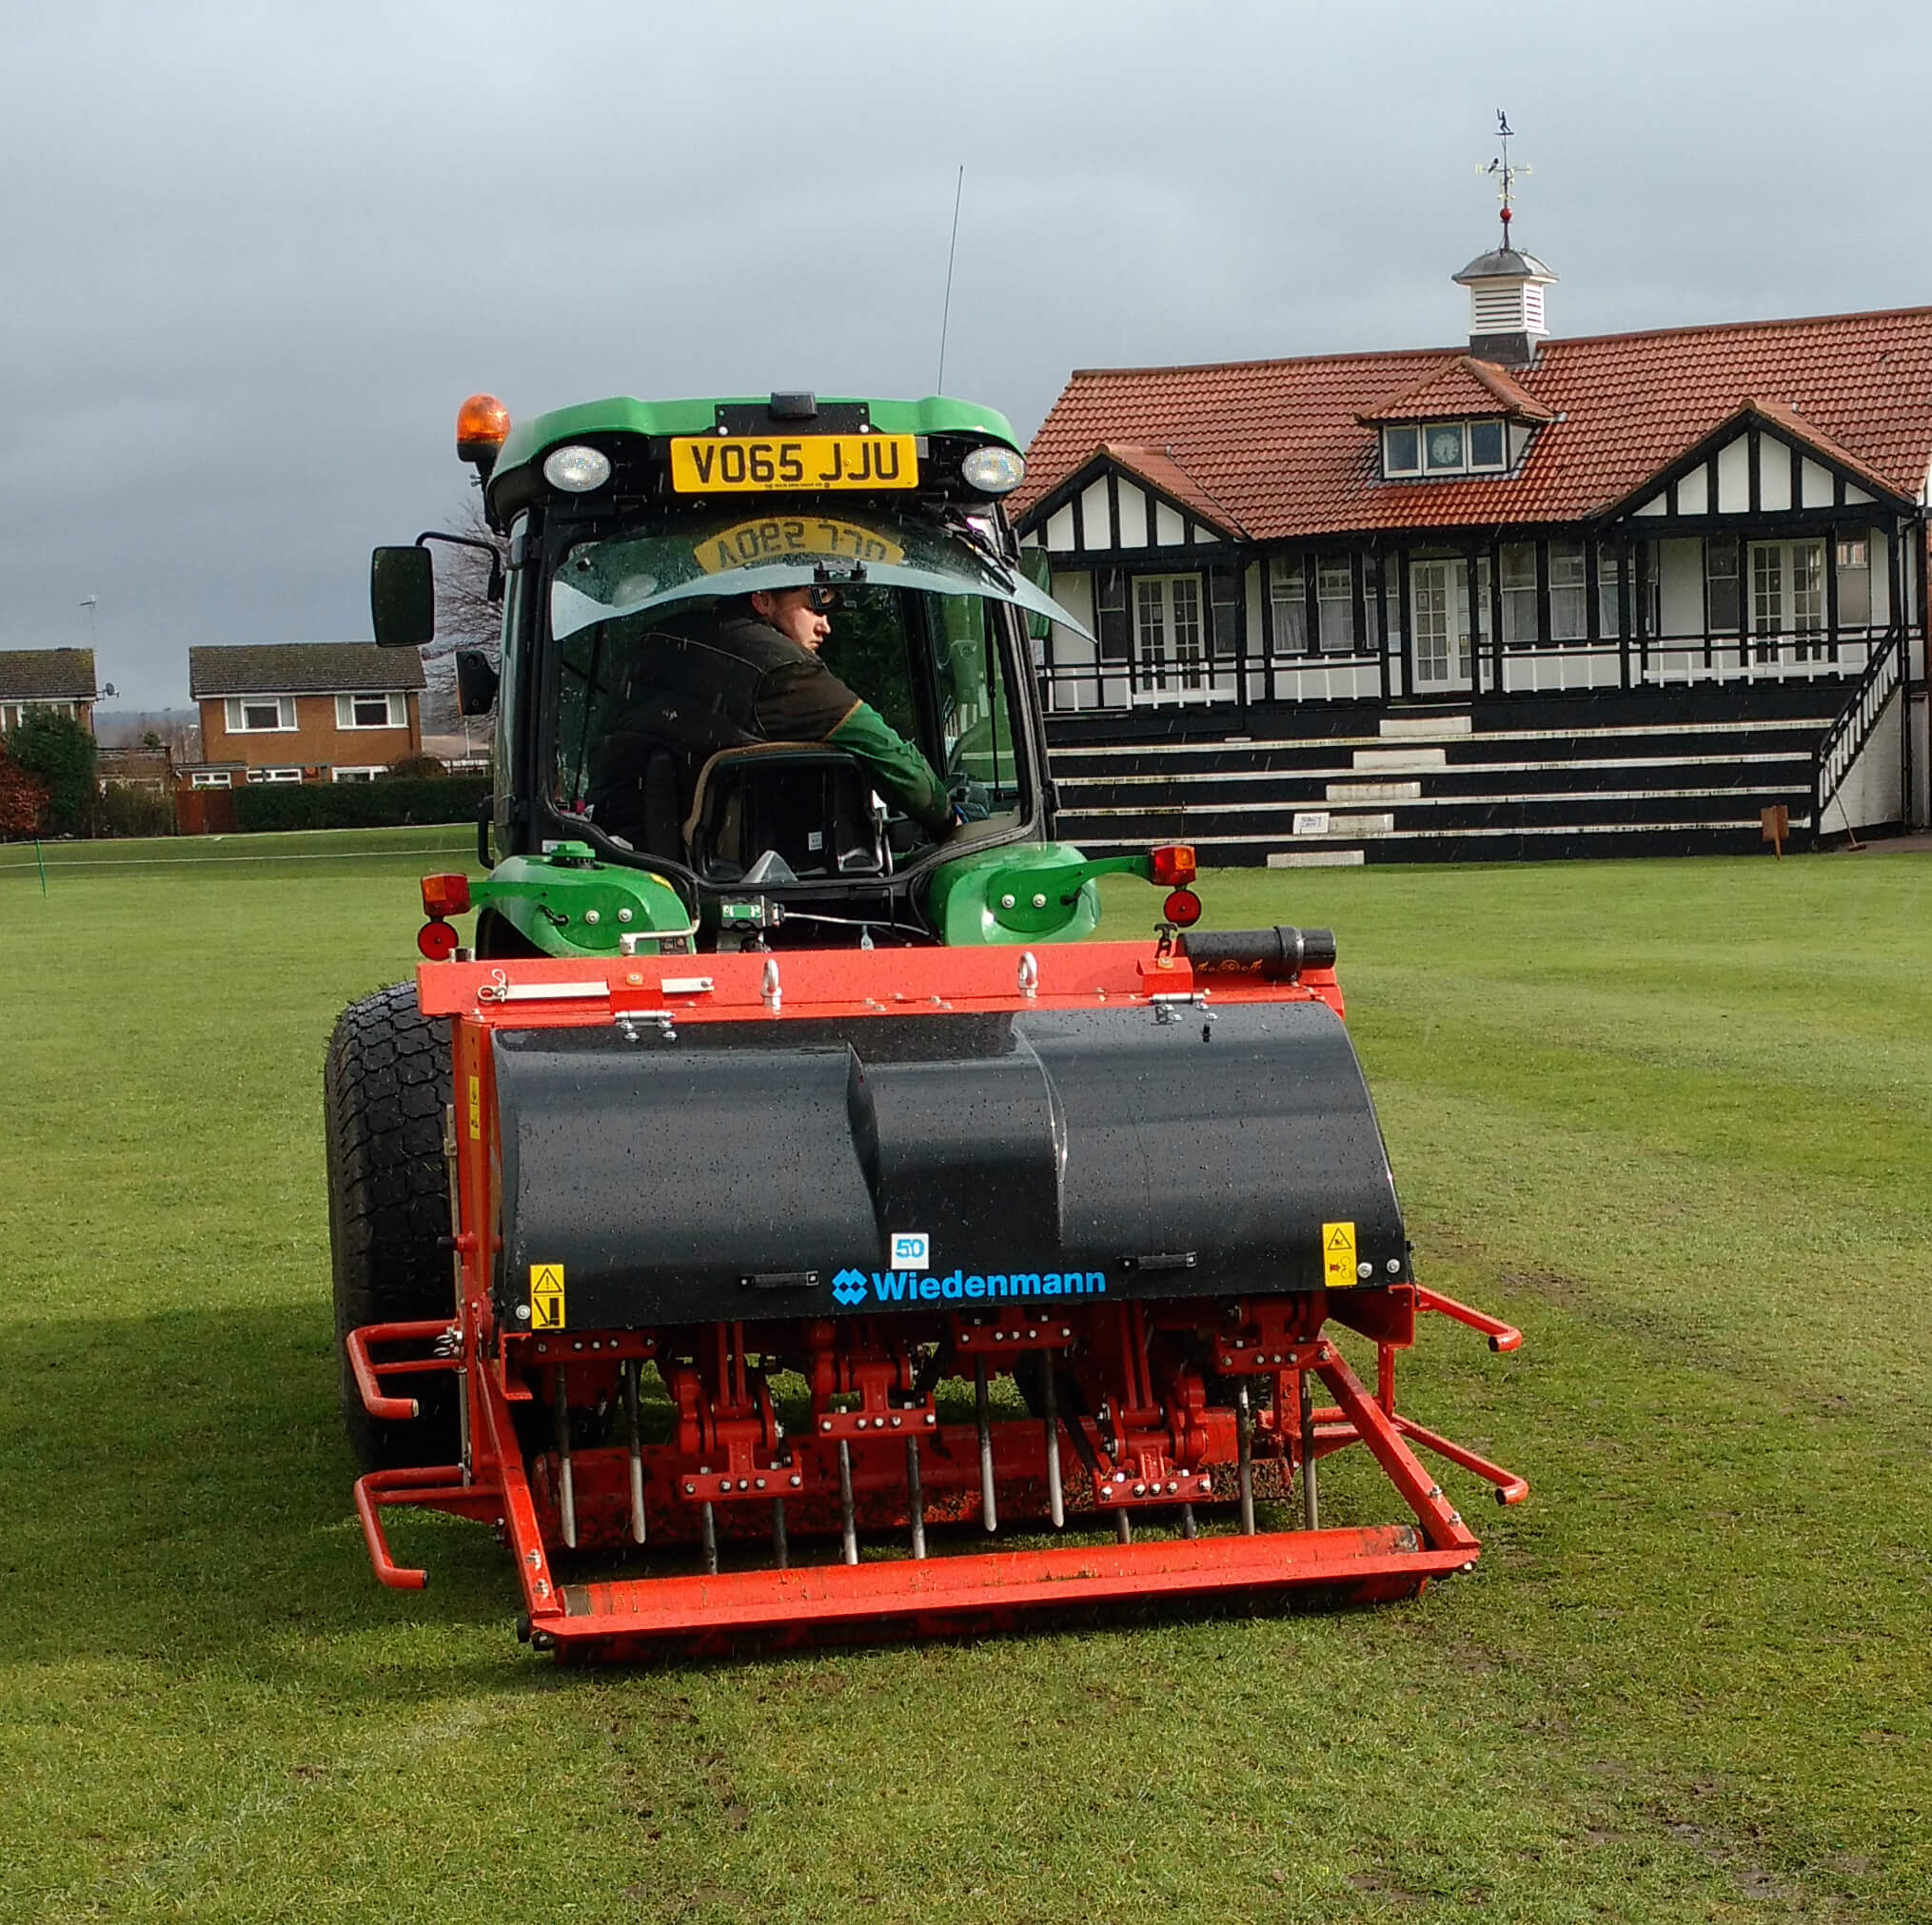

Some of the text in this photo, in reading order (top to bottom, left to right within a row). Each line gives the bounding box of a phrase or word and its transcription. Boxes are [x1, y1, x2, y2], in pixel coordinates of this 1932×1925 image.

[691, 441, 899, 483] VO65 JJU
[871, 1269, 1107, 1302] Wiedenmann
